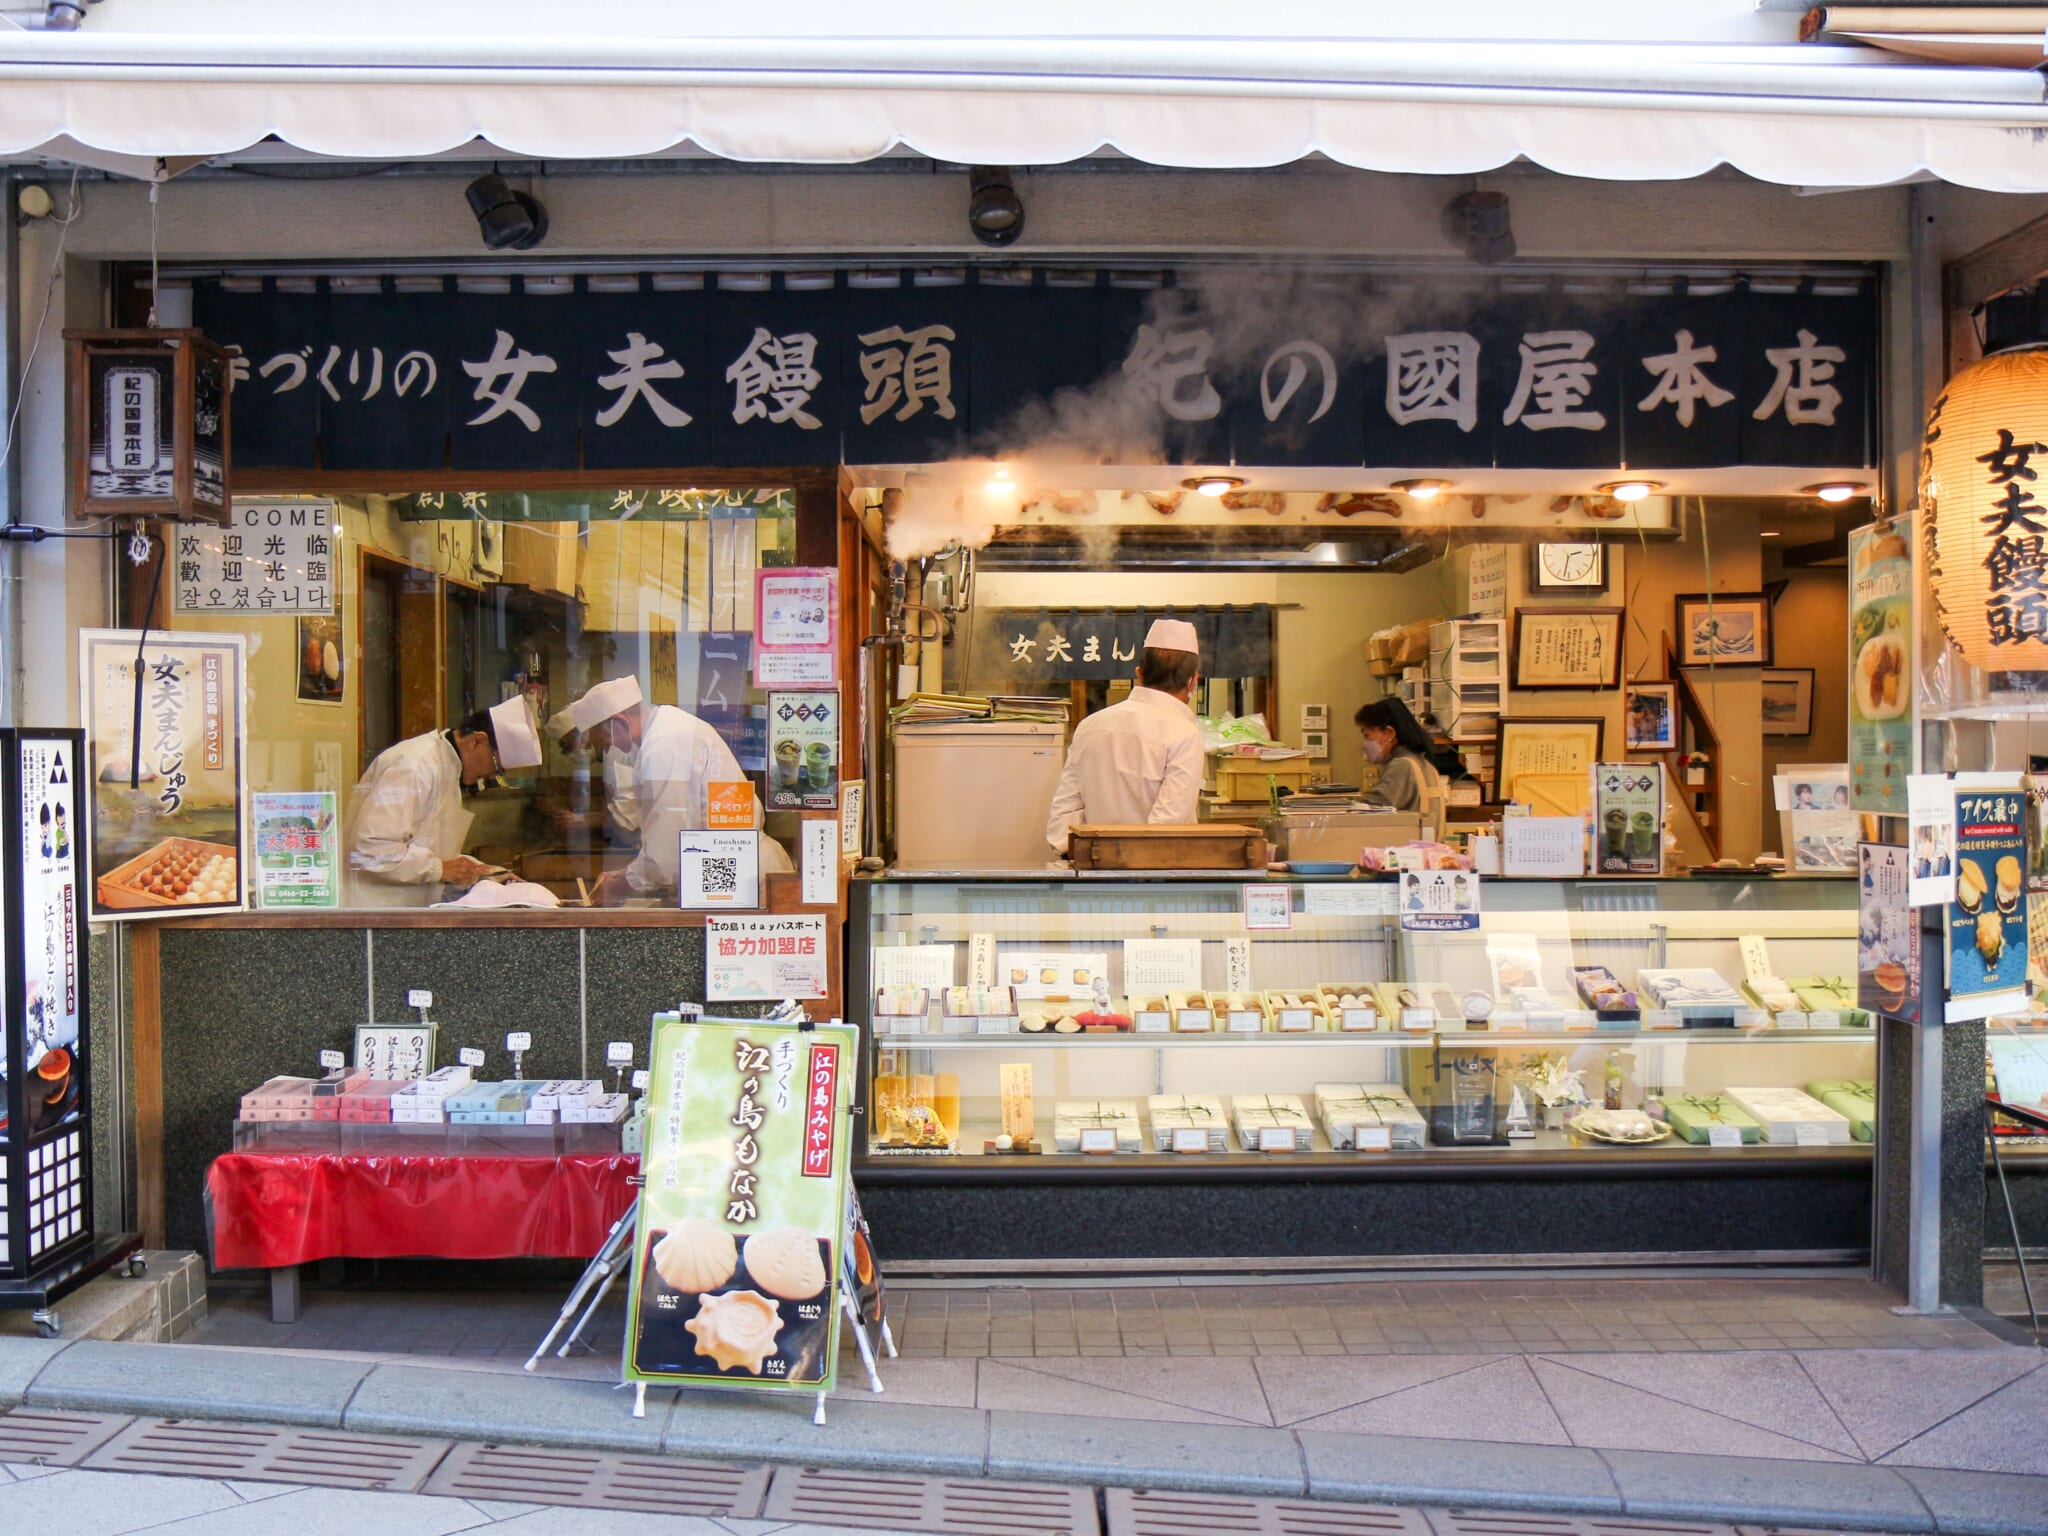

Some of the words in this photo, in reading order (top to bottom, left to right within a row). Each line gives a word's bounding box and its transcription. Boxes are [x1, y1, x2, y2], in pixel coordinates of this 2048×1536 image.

[461, 324, 957, 432] 女夫饅頭
[1121, 324, 1847, 432] 紀の國屋本店
[123, 376, 142, 466] 紀の国屋本店
[181, 534, 328, 557] 欢迎光临
[1976, 428, 2048, 647] 女夫饅頭
[180, 560, 327, 583] 歡迎光臨
[1009, 633, 1136, 664] 女夫まん
[149, 653, 187, 815] 女夫まんじゅう
[780, 706, 828, 719] 和ラテ
[207, 718, 218, 764] 手づくり
[1960, 797, 2018, 823] アイス最中
[713, 838, 752, 846] Enoshima
[718, 937, 817, 956] 協力加盟店
[672, 1051, 687, 1113] 紀の国屋本店
[776, 1040, 795, 1109] 手づくり
[726, 1039, 771, 1224] 江の島もなか
[809, 1052, 834, 1168] 江の島みやげ
